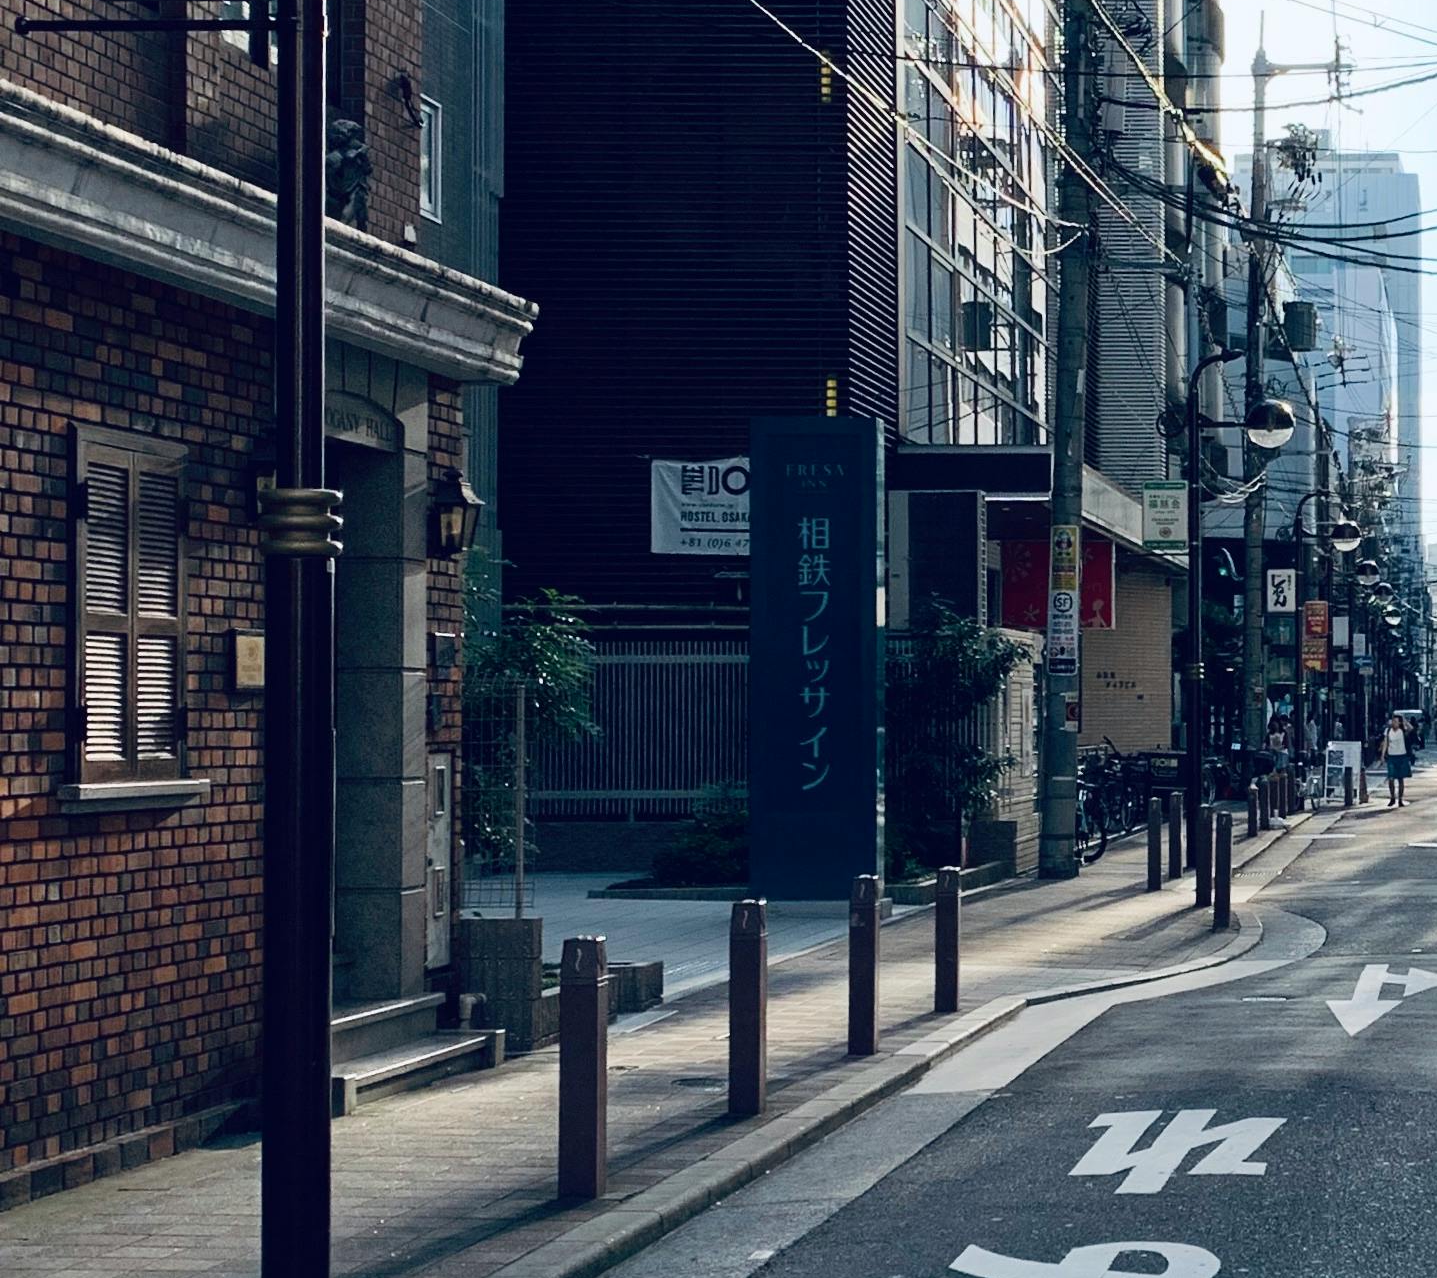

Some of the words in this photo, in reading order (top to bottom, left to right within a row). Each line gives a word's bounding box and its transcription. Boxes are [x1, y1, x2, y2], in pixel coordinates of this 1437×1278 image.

[681, 464, 704, 496] THE
[680, 538, 702, 547] +81
[797, 516, 832, 791] 相鉄フレッサイン
